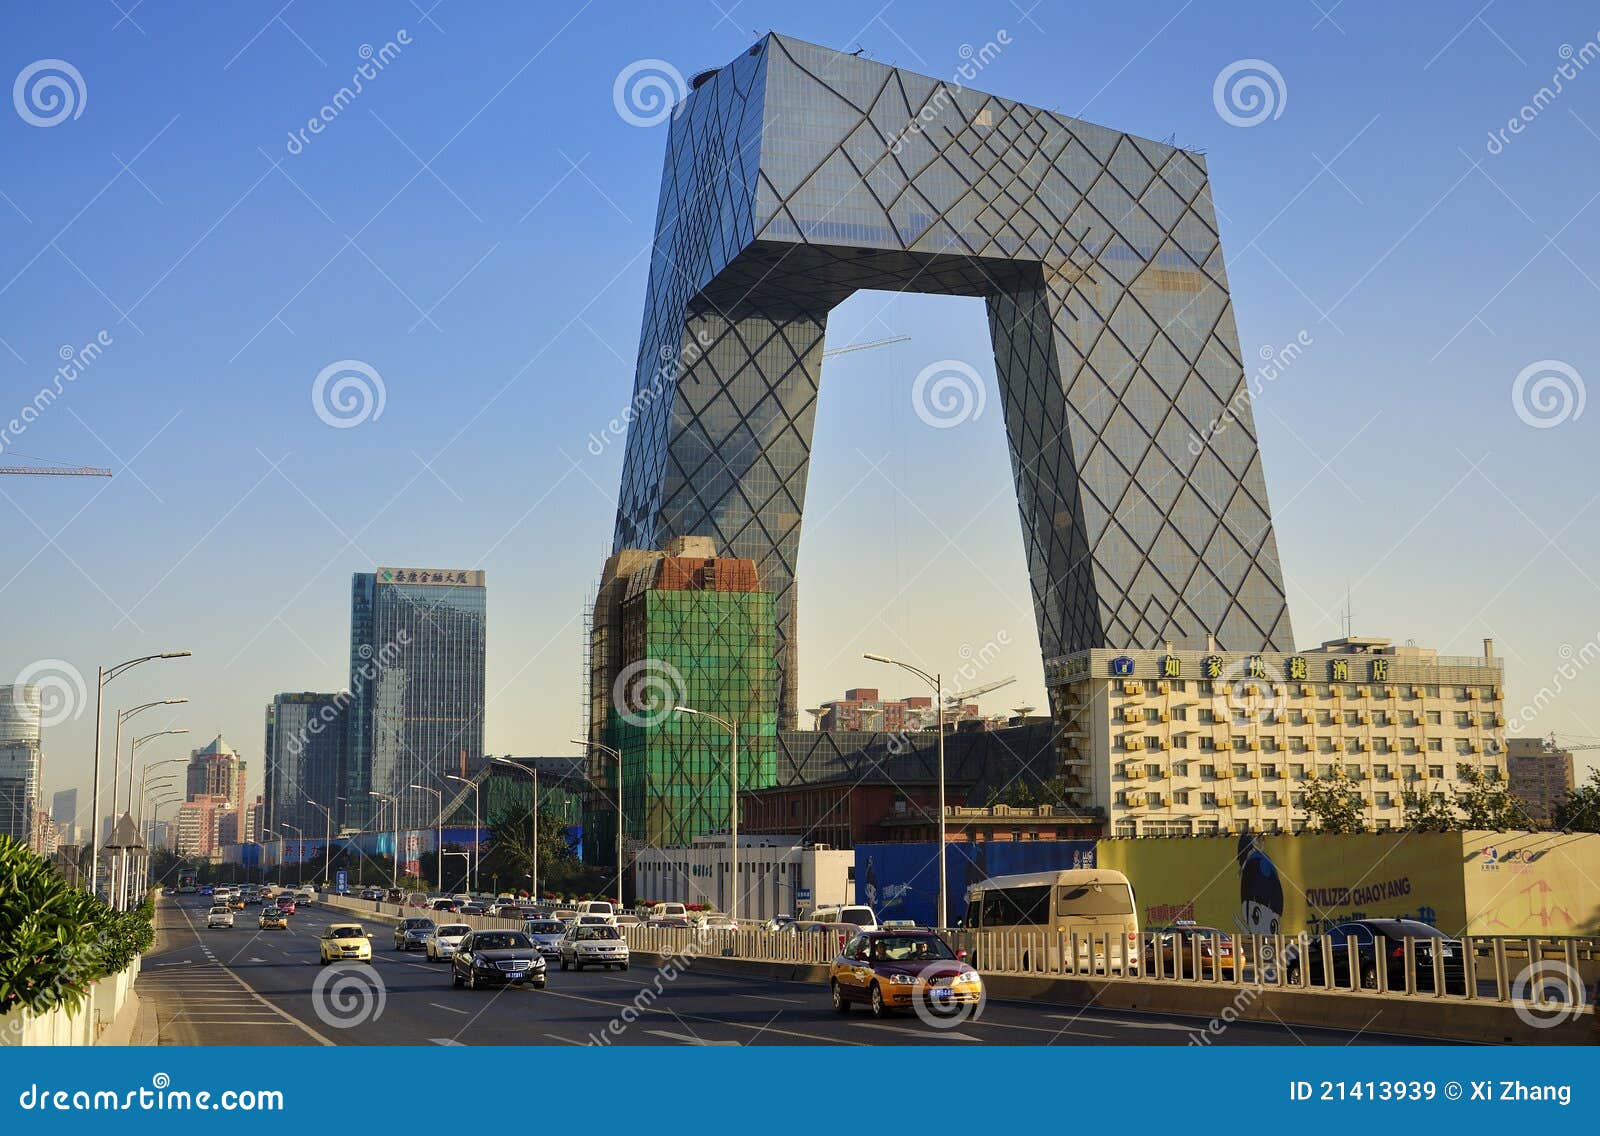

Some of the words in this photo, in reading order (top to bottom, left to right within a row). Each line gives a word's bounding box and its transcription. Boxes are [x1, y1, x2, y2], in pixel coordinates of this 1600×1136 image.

[1163, 654, 1389, 681] 如家快捷酒店
[1306, 887, 1350, 908] CIVILIZED
[1352, 876, 1411, 906] CHAOYANG
